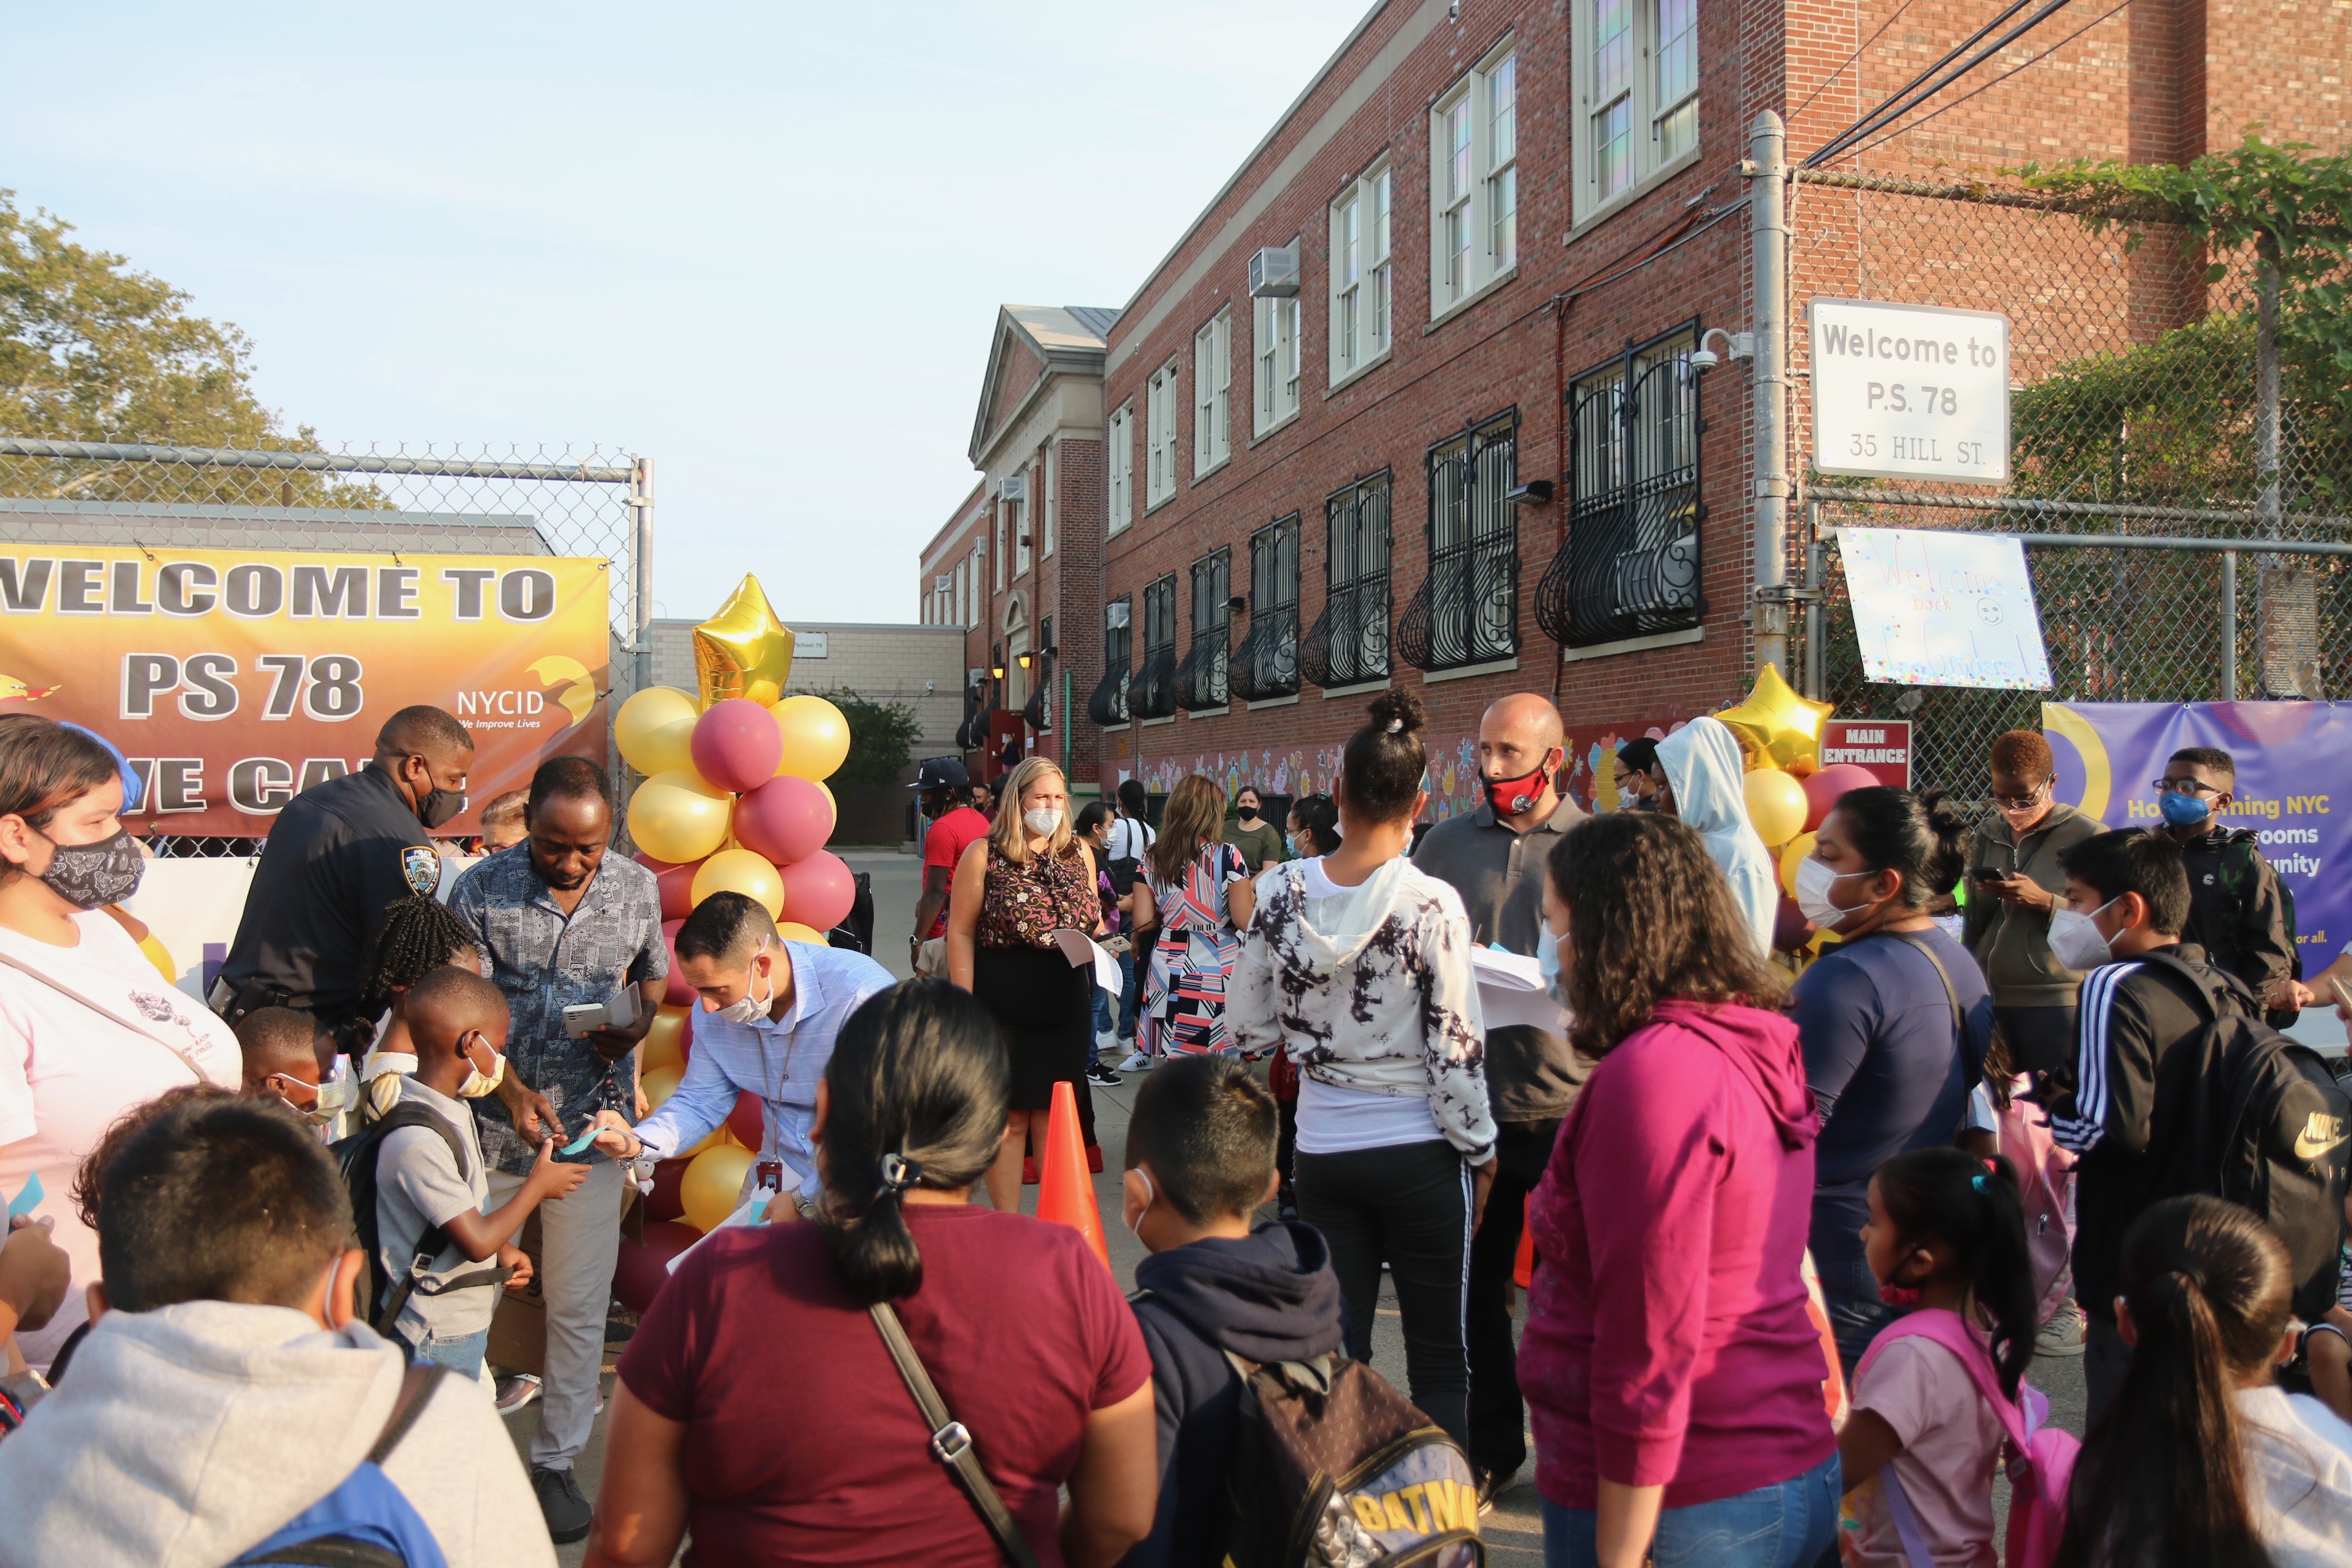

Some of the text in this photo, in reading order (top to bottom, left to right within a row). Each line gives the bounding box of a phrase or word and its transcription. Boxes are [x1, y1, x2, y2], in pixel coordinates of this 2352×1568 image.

[1823, 324, 1996, 368] Welcome to
[1867, 382, 1957, 416] P.S. 78
[1850, 433, 1986, 466] 35 HILL ST.
[1865, 534, 2007, 595] Welcome
[442, 568, 556, 622] TO
[122, 652, 363, 721] PS 78
[458, 691, 544, 714] NYCID
[476, 720, 514, 730] Improve
[517, 719, 540, 728] Lives
[1845, 729, 1885, 743] MAIN
[1824, 749, 1905, 763] ENTRANCE
[2128, 795, 2330, 819] Homing NYC
[406, 855, 436, 864] DEPARTMENT
[406, 868, 415, 881] CITY
[425, 882, 434, 892] NEW
[2311, 930, 2328, 943] all.
[2305, 1112, 2341, 1144] NIKE
[2304, 1162, 2346, 1181] AIR
